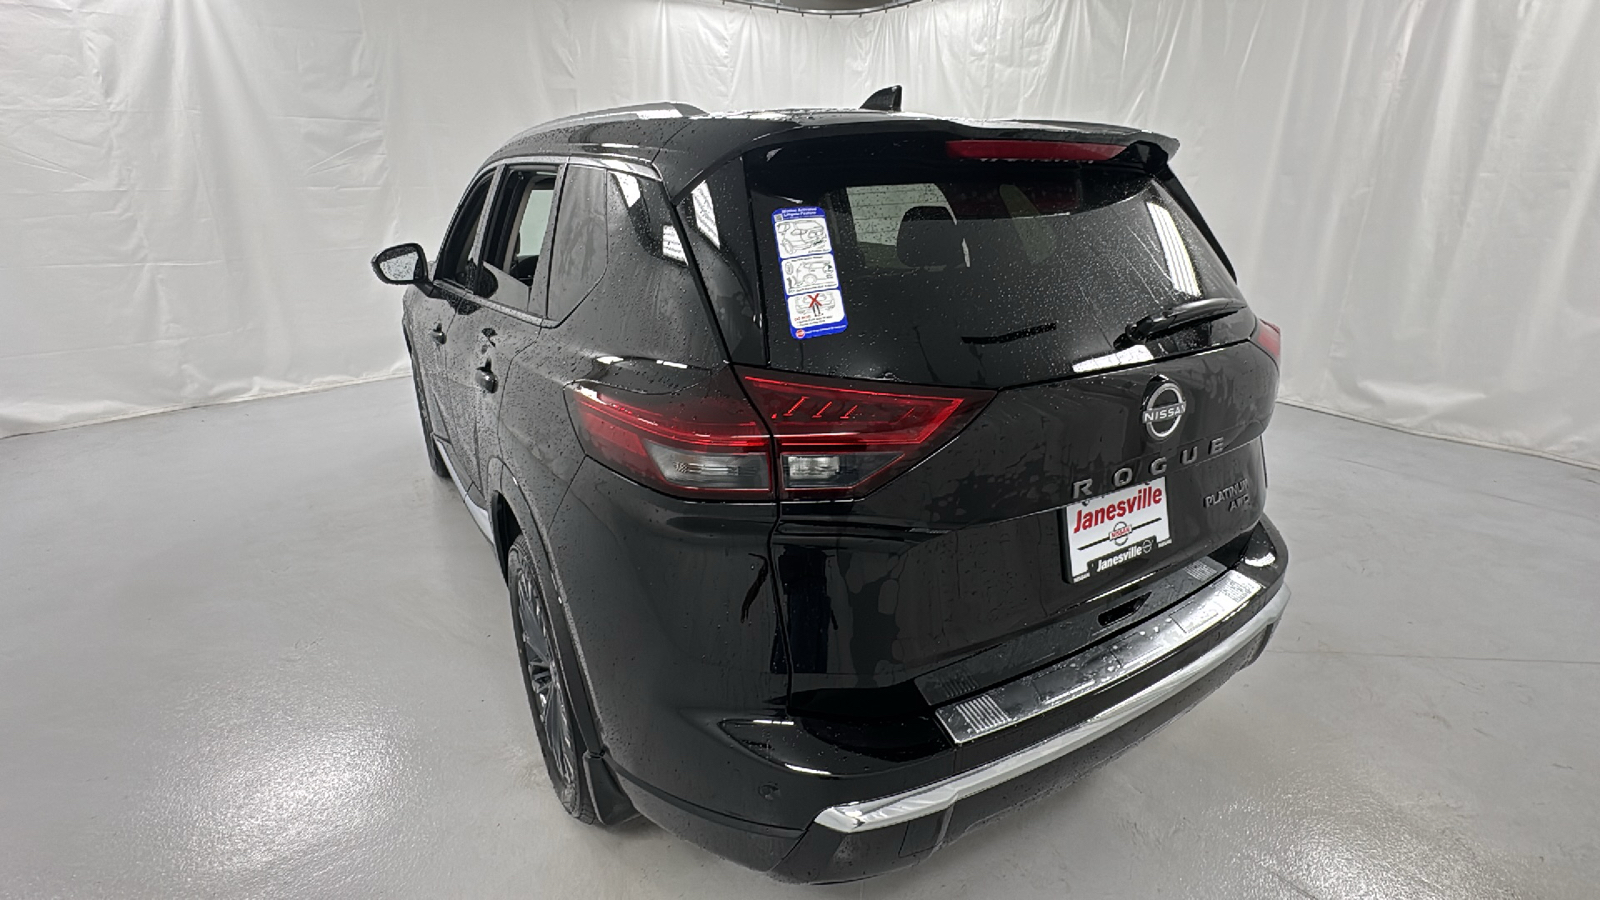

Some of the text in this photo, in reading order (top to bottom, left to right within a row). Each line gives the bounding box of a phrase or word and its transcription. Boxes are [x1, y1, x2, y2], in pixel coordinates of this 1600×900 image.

[1144, 402, 1187, 422] NISSAN
[1072, 437, 1225, 499] ROGUE
[1204, 478, 1249, 508] PLATINUM
[1073, 486, 1162, 534] Janesville
[1097, 545, 1142, 572] Janesville
